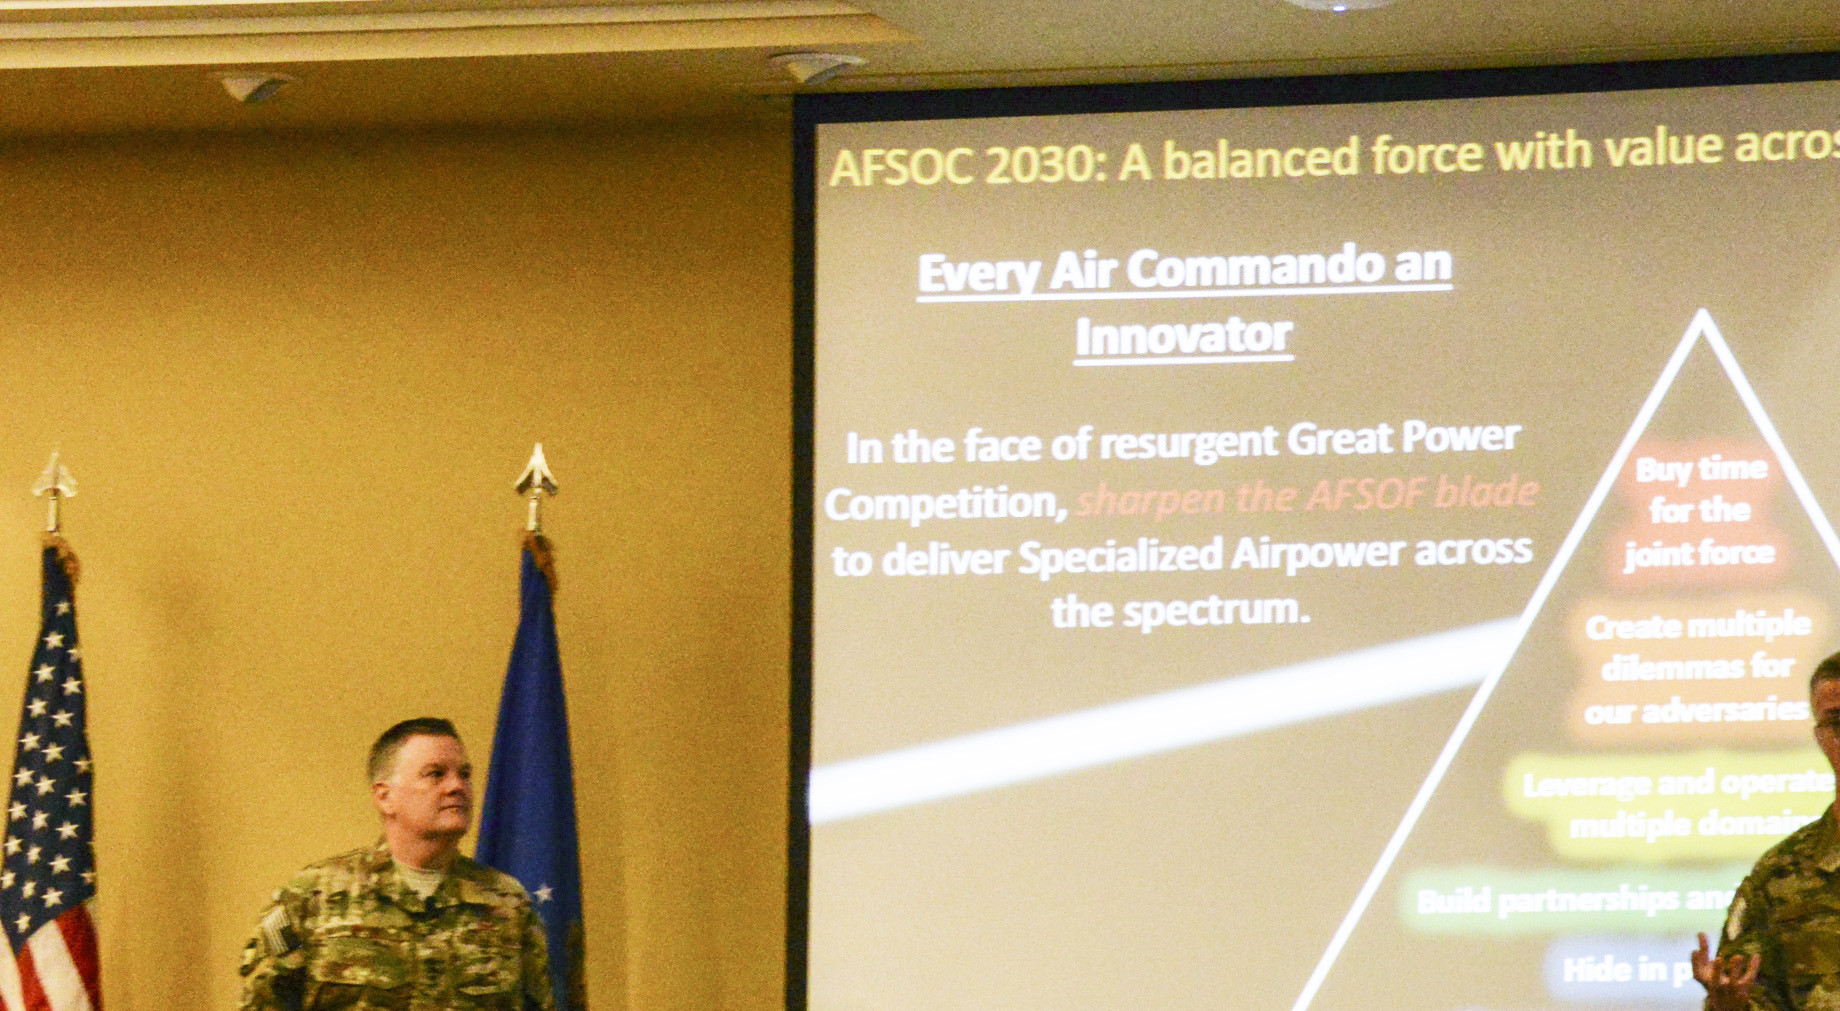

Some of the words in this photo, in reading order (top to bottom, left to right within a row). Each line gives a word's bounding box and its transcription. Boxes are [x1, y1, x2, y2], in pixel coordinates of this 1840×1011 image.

[830, 148, 974, 186] AFSOC
[986, 145, 1107, 184] 2030:
[1119, 144, 1152, 180] A
[1164, 136, 1359, 180] balanced
[1372, 135, 1484, 174] force
[1494, 129, 1592, 171] with
[1605, 125, 1723, 167] value
[918, 253, 1042, 296] Every
[1049, 249, 1119, 289] Air
[1127, 242, 1384, 289] Commando
[1394, 250, 1453, 282] an
[1076, 316, 1295, 355] Innovator
[847, 432, 883, 464] In
[890, 429, 955, 463] the
[963, 427, 1042, 462] face
[1050, 425, 1093, 460] of
[1100, 426, 1279, 466] resurgent
[1287, 421, 1394, 455] Great
[1402, 419, 1522, 453] Power
[1636, 457, 1694, 487] Buy
[1697, 455, 1770, 481] time
[824, 485, 1068, 527] Competition,
[1077, 483, 1226, 523] sharpen
[1236, 478, 1298, 512] the
[1304, 476, 1430, 512] AFSOF
[1435, 473, 1541, 509] blade
[1649, 496, 1694, 523] for
[1699, 495, 1751, 522] the
[831, 547, 873, 577] to
[882, 541, 1010, 576] deliver
[1019, 535, 1224, 582] Specialized
[1230, 535, 1407, 576] Airpower
[1415, 538, 1533, 566] across
[1623, 541, 1694, 574] joint
[1697, 538, 1775, 565] force
[1050, 593, 1114, 628] the
[1123, 595, 1311, 634] spectrum.
[1586, 615, 1683, 640] Create
[1687, 608, 1812, 642] multiple
[1601, 653, 1746, 681] dilemmas
[1750, 650, 1795, 677] for
[1585, 703, 1635, 726] our
[1641, 695, 1809, 724] adversaries
[1523, 773, 1652, 802] Leverage
[1657, 767, 1716, 795] and
[1719, 769, 1836, 800] operate
[1570, 809, 1692, 843] multiple
[1697, 808, 1822, 834] domain
[1417, 885, 1492, 914] Build
[1498, 883, 1680, 920] partnerships
[1563, 954, 1632, 983] Hide
[1637, 954, 1668, 982] in
